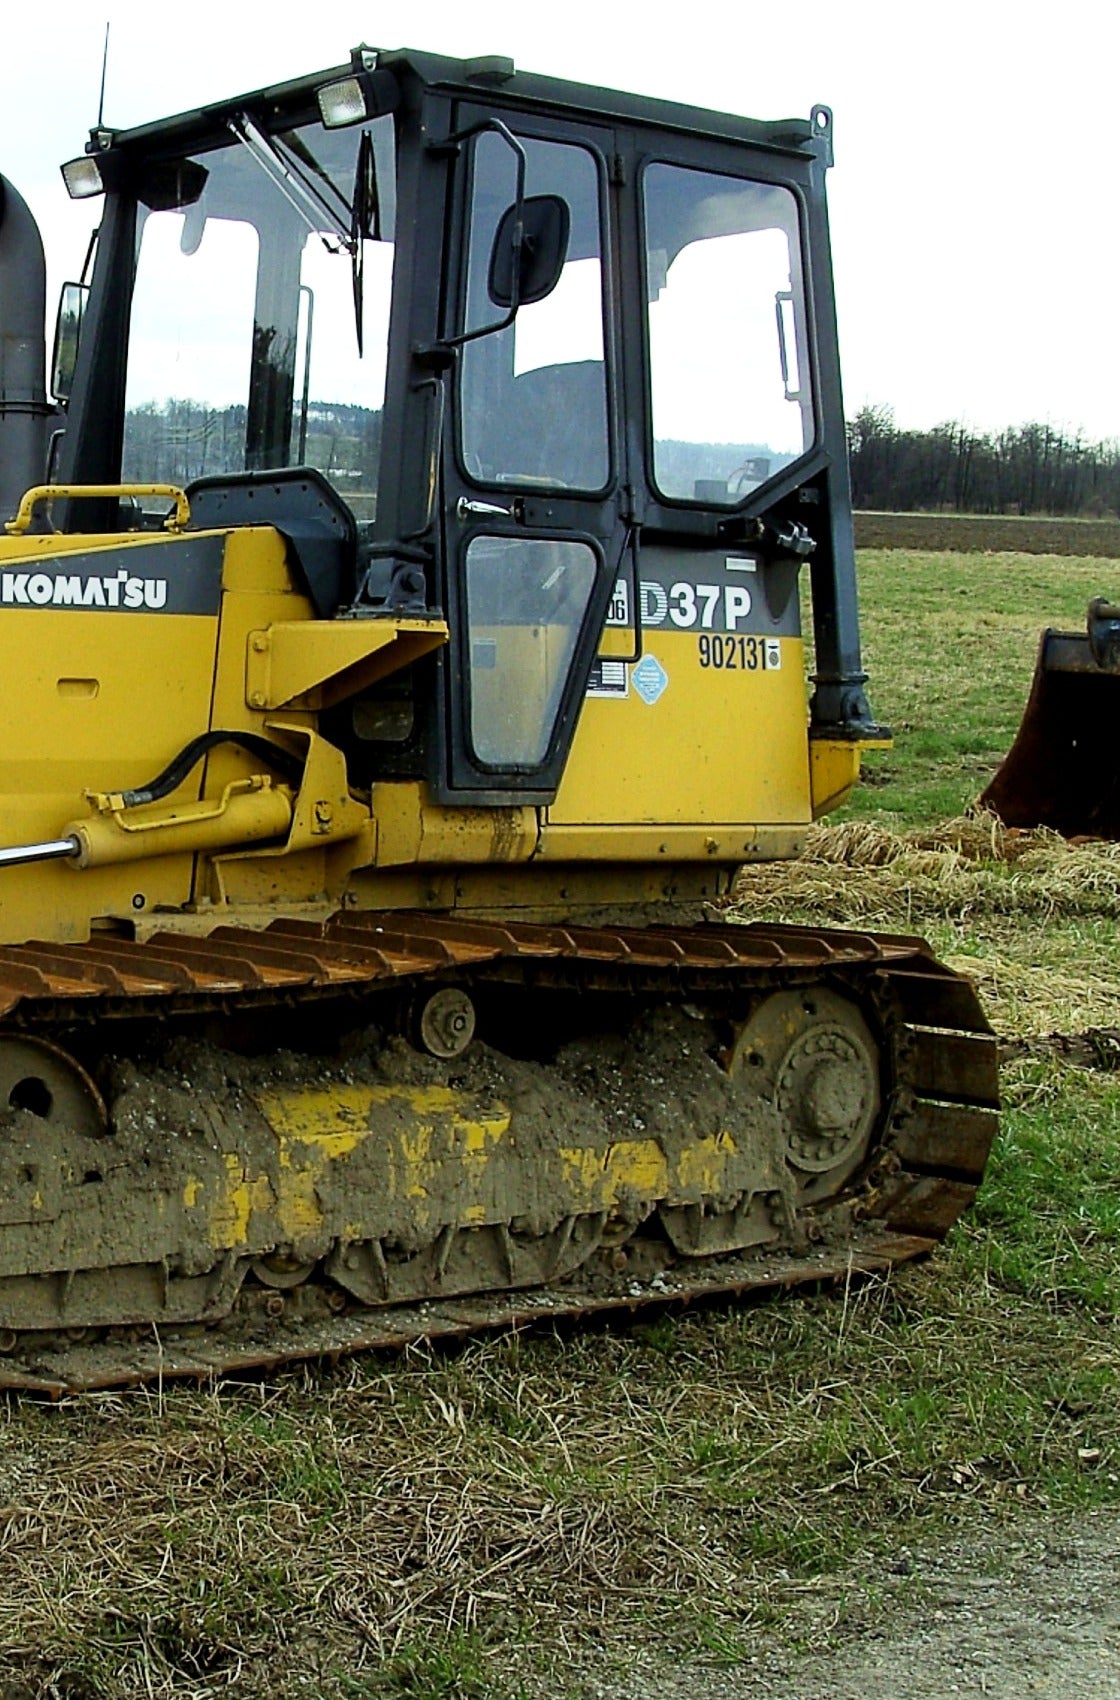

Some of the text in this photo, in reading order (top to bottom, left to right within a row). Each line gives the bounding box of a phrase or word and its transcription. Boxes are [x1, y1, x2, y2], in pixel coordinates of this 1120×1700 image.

[1, 569, 167, 608] KOMATSU
[640, 581, 752, 630] D37P
[698, 635, 766, 670] 902131
